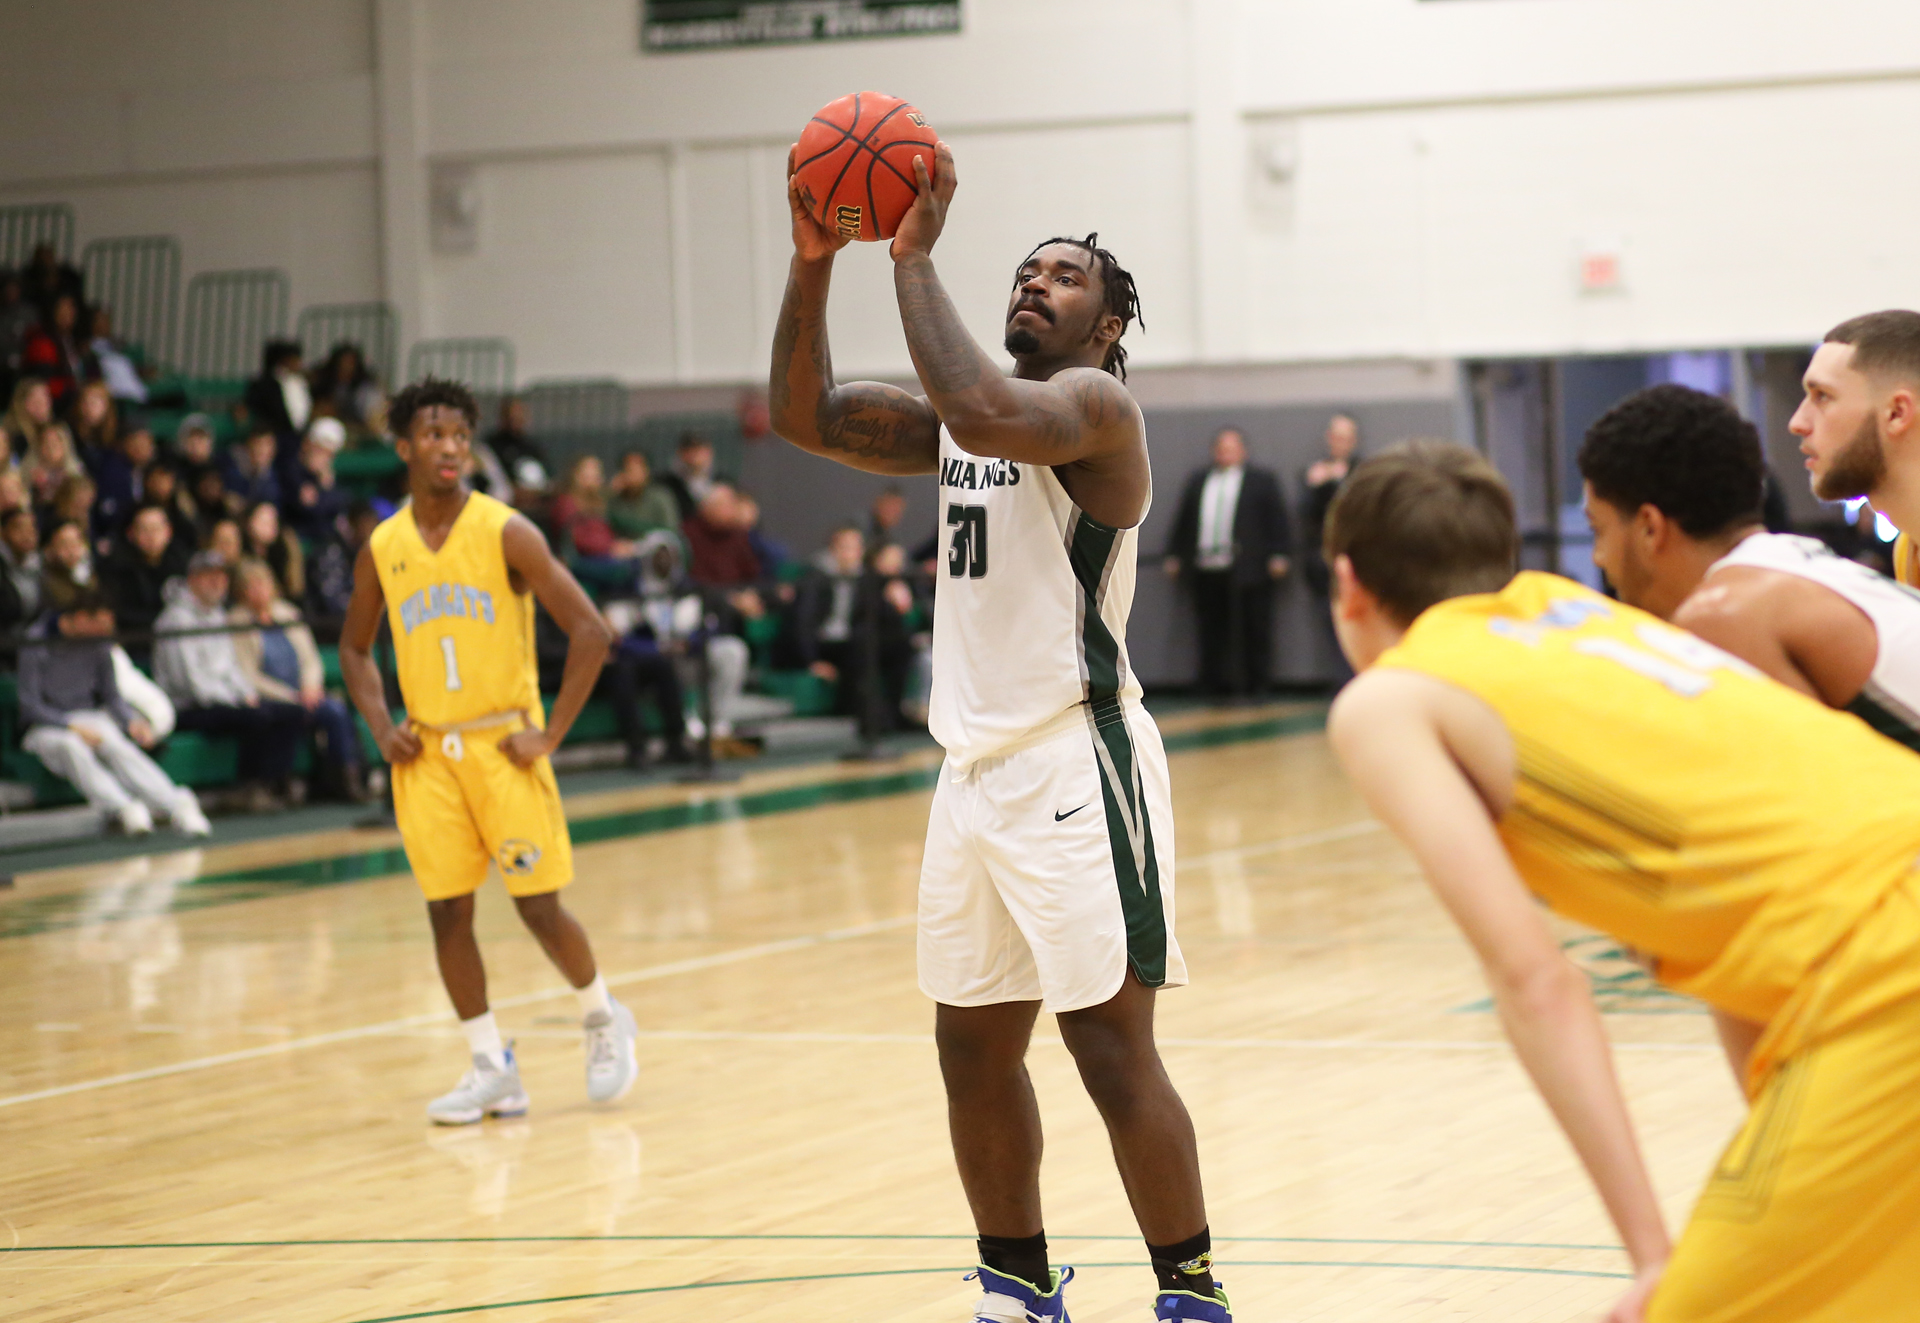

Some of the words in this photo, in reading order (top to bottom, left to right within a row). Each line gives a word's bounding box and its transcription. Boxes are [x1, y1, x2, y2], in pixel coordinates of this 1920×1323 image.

[947, 502, 988, 580] 30
[400, 582, 495, 635] WILDCATS
[440, 636, 462, 691] 1
